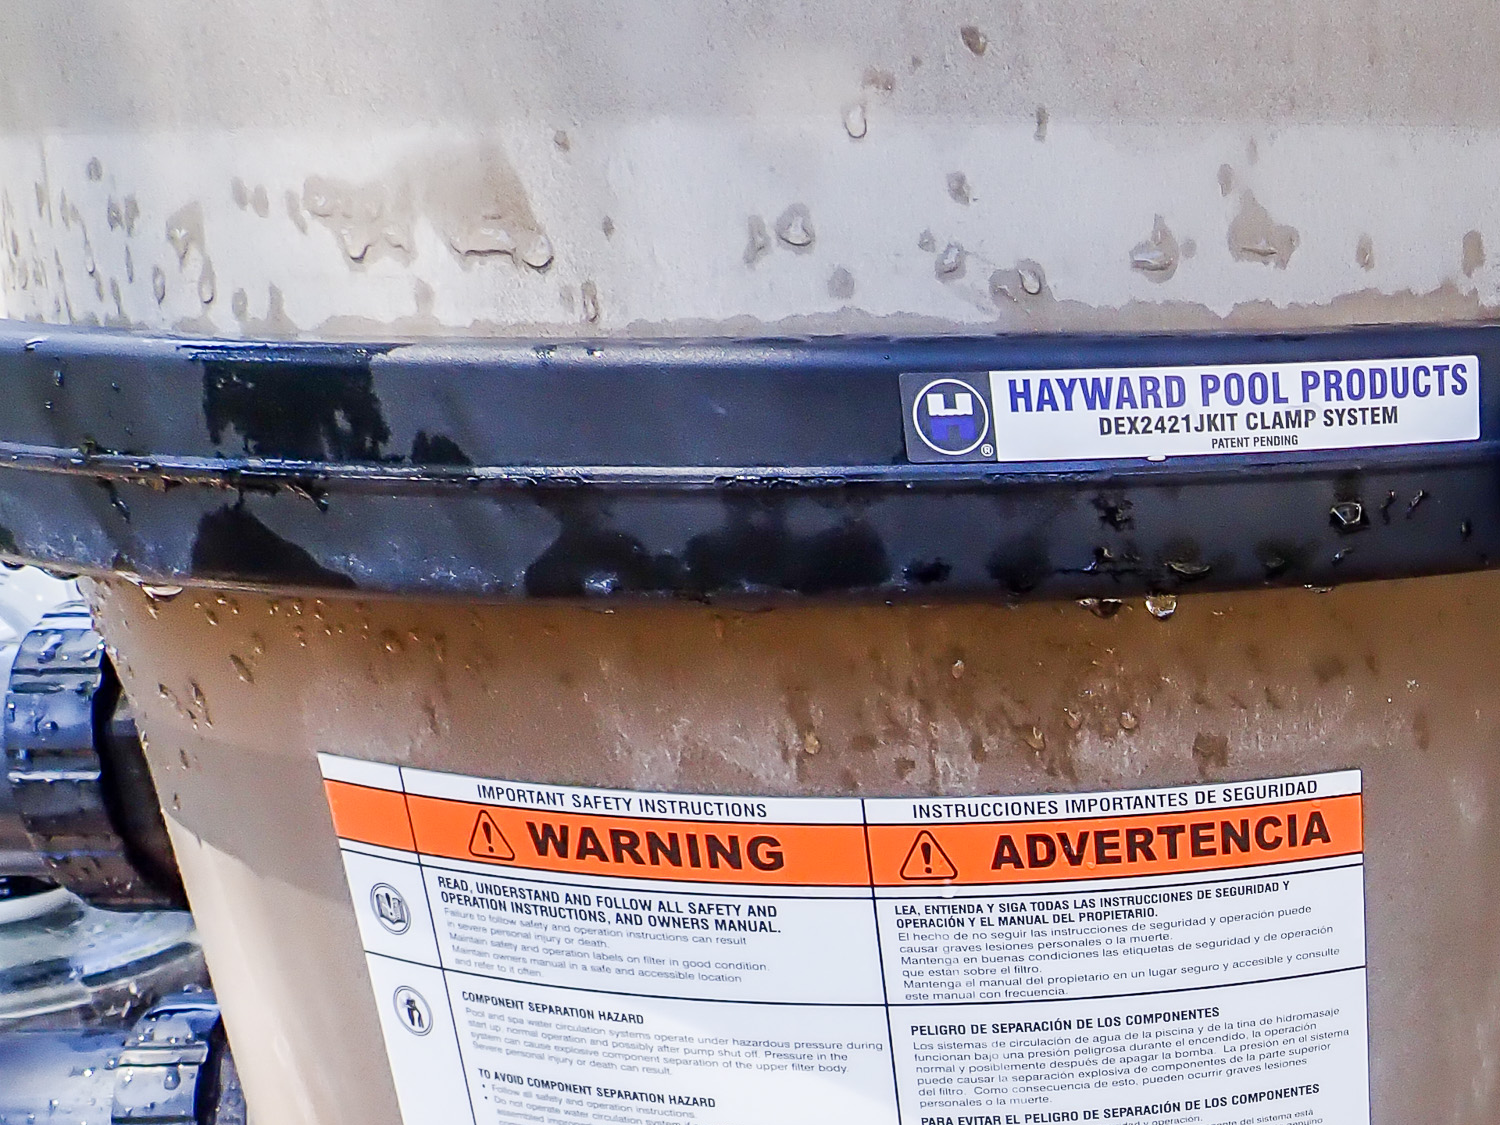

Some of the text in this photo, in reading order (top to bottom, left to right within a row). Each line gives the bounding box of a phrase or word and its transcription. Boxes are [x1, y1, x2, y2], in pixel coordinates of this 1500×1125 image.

[1007, 363, 1468, 413] HAYWARD POOL PRODUCTS
[1098, 405, 1398, 436] DEX2421JKIT CLAMP SYSTEM
[1211, 434, 1298, 449] PATENT PENDING
[476, 784, 767, 818] IMPORTANT SAFETY INSTRUCTIONS
[912, 780, 1317, 819] INSTRUCCIONES IMPORTANTES DE SEGURIDAD
[525, 820, 786, 872] WARNING
[990, 811, 1332, 871] ADVERTENCIA
[440, 890, 781, 933] OPERATION INSTRUCTIONS, AND OWNERS MANUAL.
[475, 881, 559, 903] UNDERSTAND
[564, 892, 591, 906] AND
[595, 895, 652, 912] FOLLOW
[657, 900, 684, 914] ALL
[687, 901, 741, 917] SAFETY
[747, 904, 777, 917] AND
[894, 880, 1290, 916] LEA, ENTIENDA Y SIGA TODAS LAS INSTRUCCIONES DE SEGURIDAD Y
[896, 907, 1158, 929] OPERACIÓN Y EL MANUAL DEL PROPIETARIO.
[897, 905, 1311, 942] El hecho de no seguir las instrucciones de seguridad y operación puede
[899, 945, 938, 953] causar
[942, 944, 982, 954] graves
[985, 941, 1034, 951] lesiones
[1037, 937, 1101, 951] personales
[1115, 935, 1126, 945] la
[1129, 932, 1172, 943] muerte.
[900, 925, 1333, 966] Mantenga en buenas condiciones las etiquetas de seguridad y de operación
[901, 964, 1042, 979] que están sobre el filtro.
[461, 990, 644, 1024] COMPONENT SEPARATION HAZARD
[910, 1006, 1219, 1036] PELIGRO DE SEPARACIÓN DE LOS COMPONENTES
[554, 1023, 606, 1035] circulation
[608, 1029, 651, 1040] systems
[653, 1033, 694, 1043] operate
[697, 1036, 729, 1046] under
[731, 1037, 790, 1048] hazardous
[793, 1038, 843, 1050] pressure
[846, 1039, 884, 1053] during
[477, 1067, 715, 1108] TO AVOID COMPONENT SEPARATION HAZARD
[1004, 1114, 1020, 1125] EL
[1024, 1110, 1078, 1124] PELIGRO
[1082, 1109, 1099, 1120] DE
[1103, 1100, 1180, 1119] SEPARACIÓN
[1184, 1099, 1200, 1111] DE
[1204, 1096, 1227, 1109] LOS
[1231, 1083, 1319, 1105] COMPONENTES
